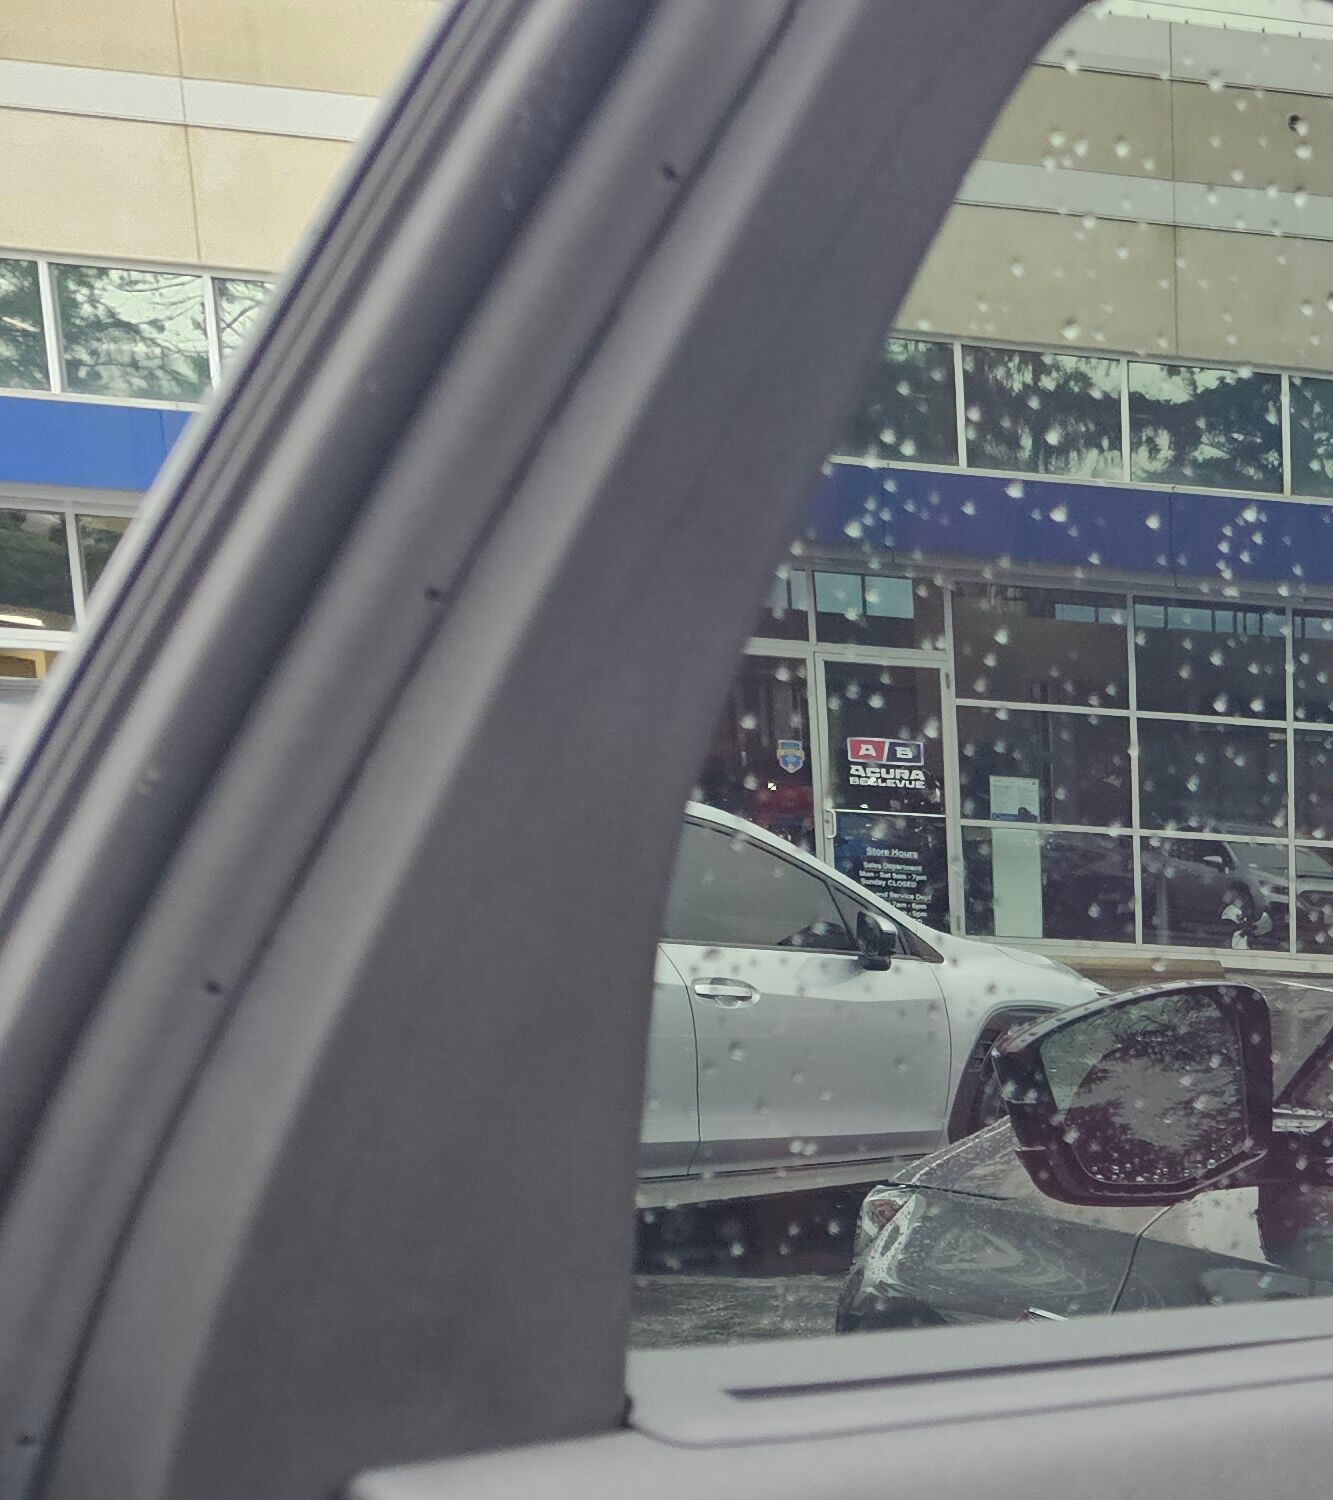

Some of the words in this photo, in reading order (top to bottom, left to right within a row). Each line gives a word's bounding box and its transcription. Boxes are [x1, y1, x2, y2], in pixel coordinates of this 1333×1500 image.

[859, 744, 876, 757] A
[895, 746, 912, 758] B
[849, 765, 925, 780] ACURA
[866, 846, 889, 856] Store
[891, 849, 918, 859] Hours
[887, 880, 917, 888] CLOSED
